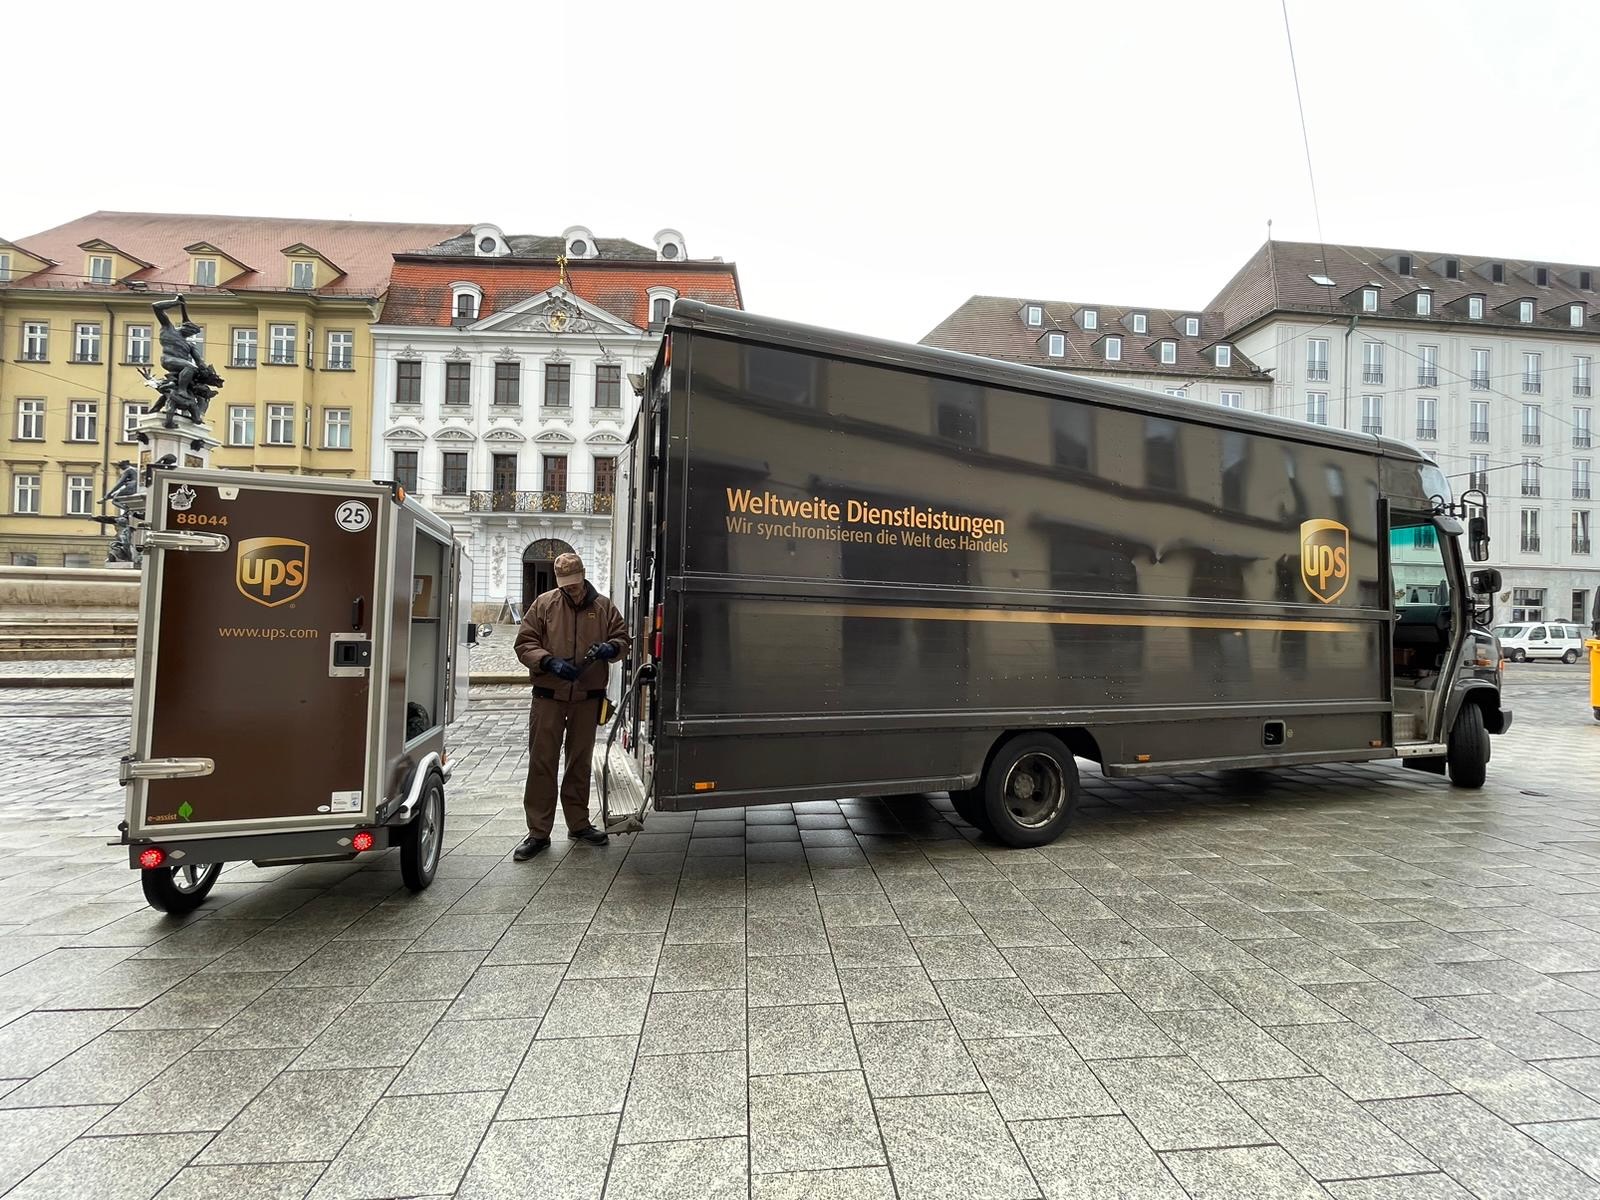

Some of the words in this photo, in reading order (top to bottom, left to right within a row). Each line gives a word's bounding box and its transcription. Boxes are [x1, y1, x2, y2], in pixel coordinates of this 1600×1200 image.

[176, 513, 229, 526] 88044
[341, 507, 365, 524] 25
[726, 487, 840, 521] Weltweite
[847, 499, 1005, 539] Dienstleistungen
[726, 516, 753, 534] Wir
[757, 521, 873, 544] synchronisieren
[876, 529, 898, 545] die
[901, 530, 931, 548] Welt
[934, 534, 956, 550] des
[959, 535, 1008, 553] Handels
[242, 558, 303, 596] ups
[1304, 544, 1346, 590] ups
[219, 627, 318, 641] www.ups.com
[147, 812, 177, 822] e-assist
